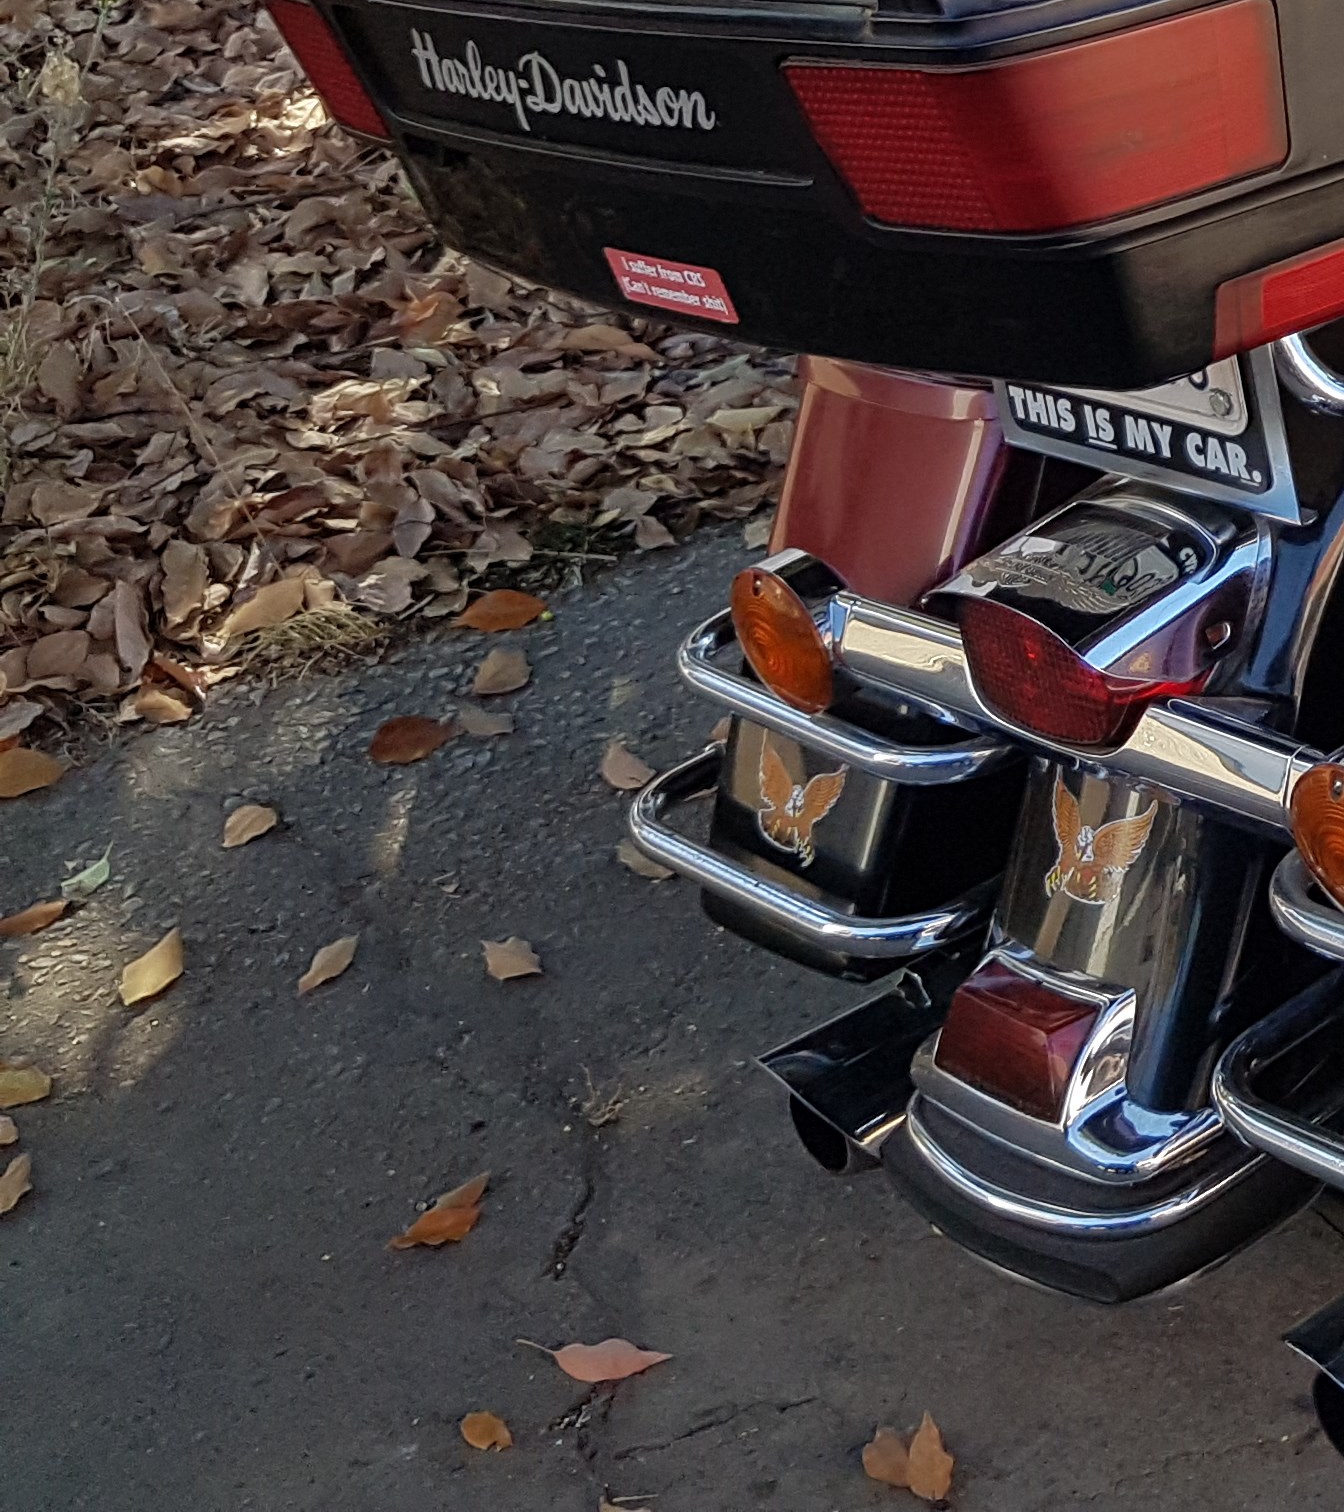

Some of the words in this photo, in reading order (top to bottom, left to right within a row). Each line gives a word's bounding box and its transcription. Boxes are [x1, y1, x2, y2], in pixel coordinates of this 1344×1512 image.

[410, 27, 716, 131] Harley-Davidson
[1007, 384, 1076, 433] THIS
[1083, 404, 1117, 444] IS
[1123, 414, 1175, 459] MY
[1185, 431, 1263, 484] CAR.
